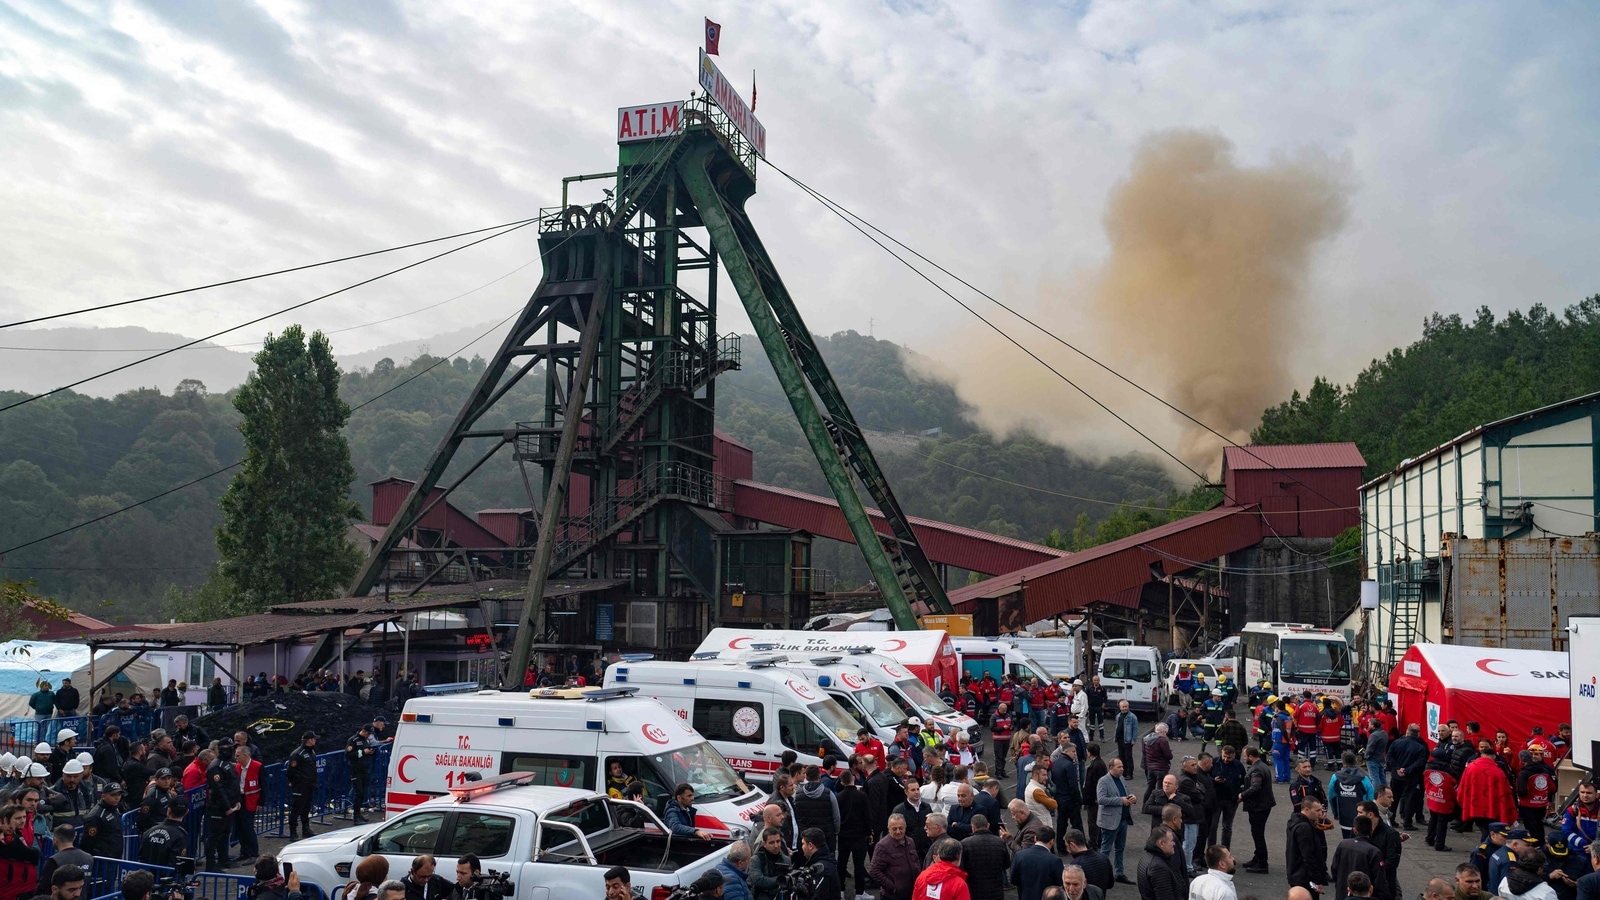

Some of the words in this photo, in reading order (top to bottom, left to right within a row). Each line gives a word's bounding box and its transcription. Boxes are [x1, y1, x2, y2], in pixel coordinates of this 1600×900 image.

[714, 72, 748, 135] AMASRA
[846, 674, 862, 684] 112
[1530, 669, 1570, 680] SAĞ
[796, 684, 810, 693] 112
[1579, 683, 1596, 698] AFAD
[649, 727, 667, 739] 112
[458, 735, 471, 750] T.C.
[435, 752, 458, 766] SAĞLIK
[459, 754, 493, 769] BAKANLIĞI
[445, 770, 467, 788] 11
